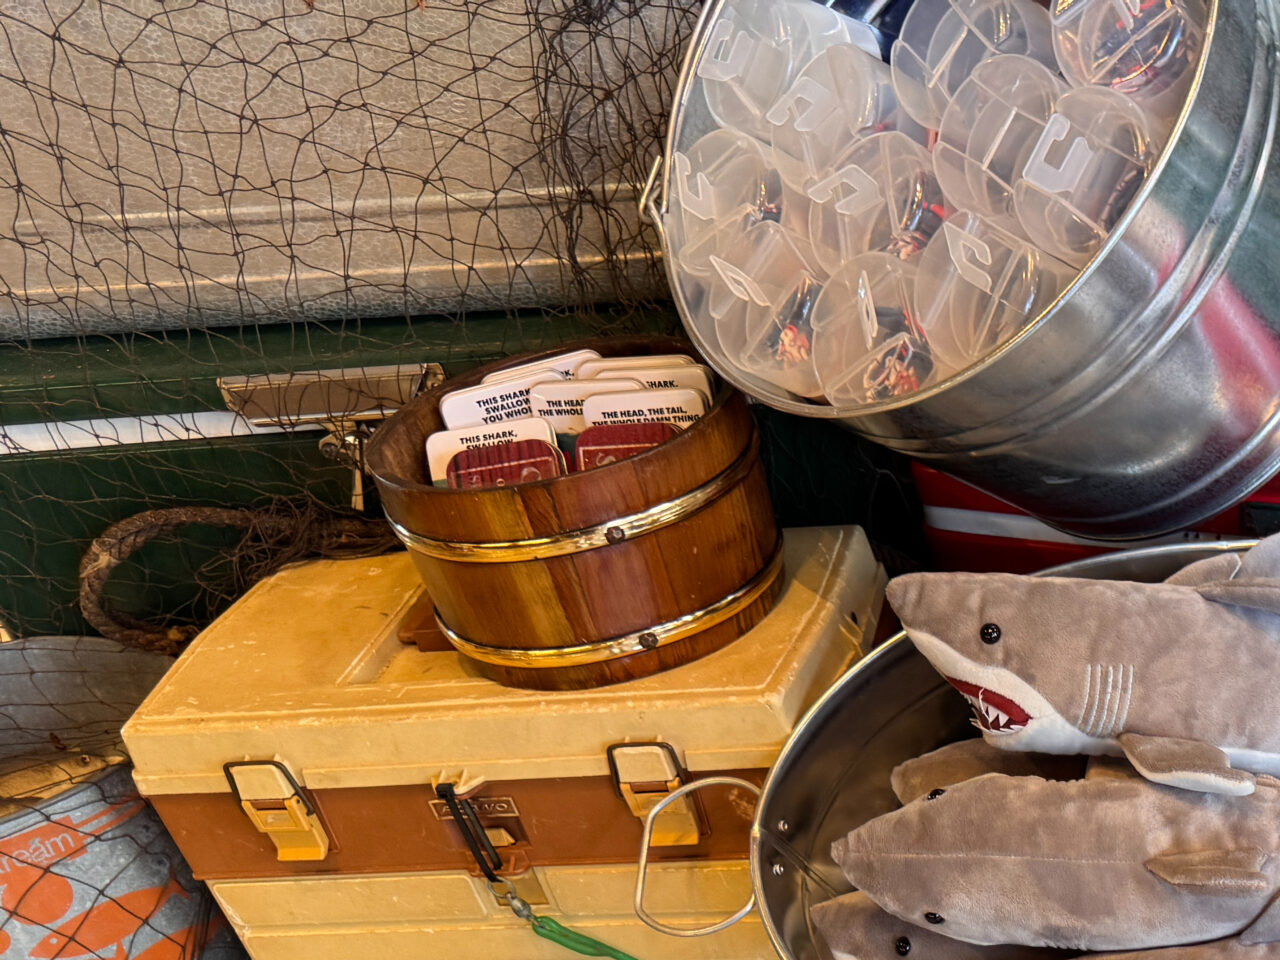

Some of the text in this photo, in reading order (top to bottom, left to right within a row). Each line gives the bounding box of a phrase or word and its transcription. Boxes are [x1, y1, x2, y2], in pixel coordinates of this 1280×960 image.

[476, 396, 498, 409] THIS
[546, 400, 563, 408] THE
[537, 409, 554, 417] THE
[601, 411, 619, 419] THE
[620, 410, 647, 418] HEAD,
[647, 408, 665, 416] THE
[482, 415, 503, 425] YOU
[591, 419, 610, 427] THE
[459, 434, 481, 445] THIS
[0, 832, 75, 875] ream
